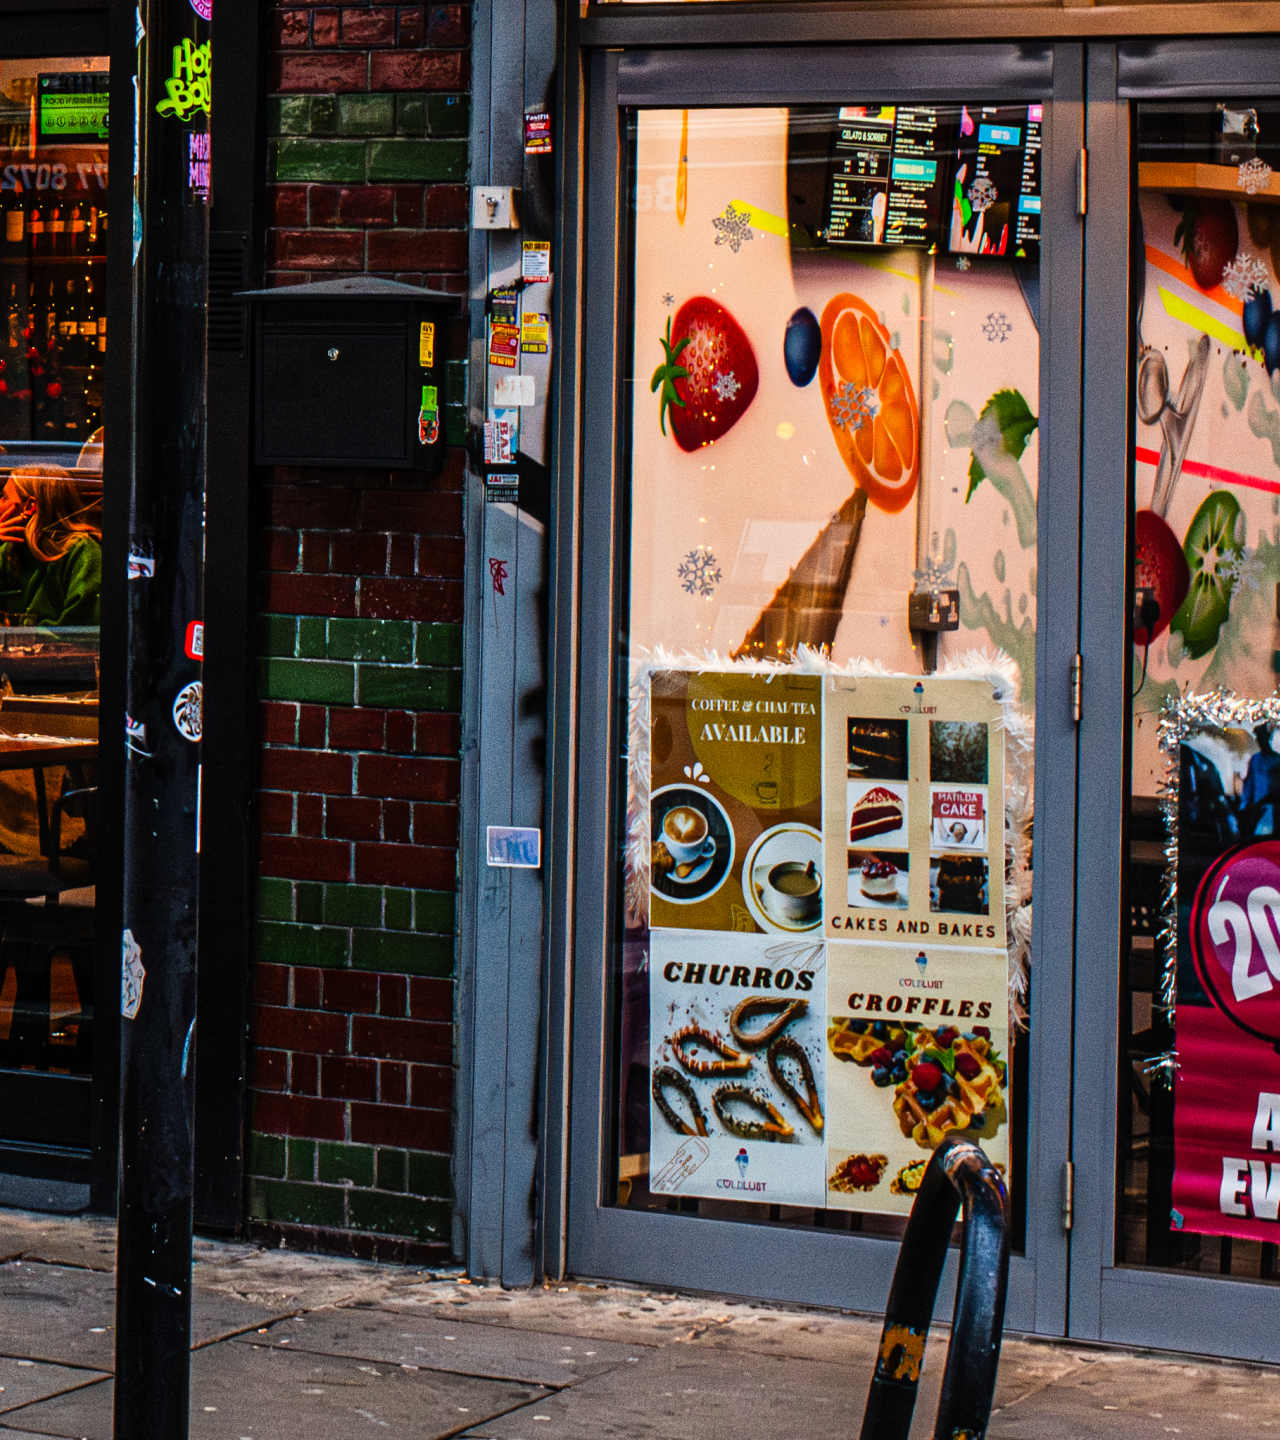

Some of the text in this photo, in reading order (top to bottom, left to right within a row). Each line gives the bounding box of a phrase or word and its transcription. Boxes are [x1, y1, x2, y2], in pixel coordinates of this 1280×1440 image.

[842, 129, 861, 142] GELATO
[866, 131, 888, 143] SORBET
[691, 698, 740, 712] COFFEE
[700, 723, 806, 745] AVAILABLE
[940, 803, 977, 816] CAKE
[831, 916, 996, 938] CAKES AND BAKES
[663, 961, 816, 991] CHURROS
[847, 993, 992, 1019] CROFFLES
